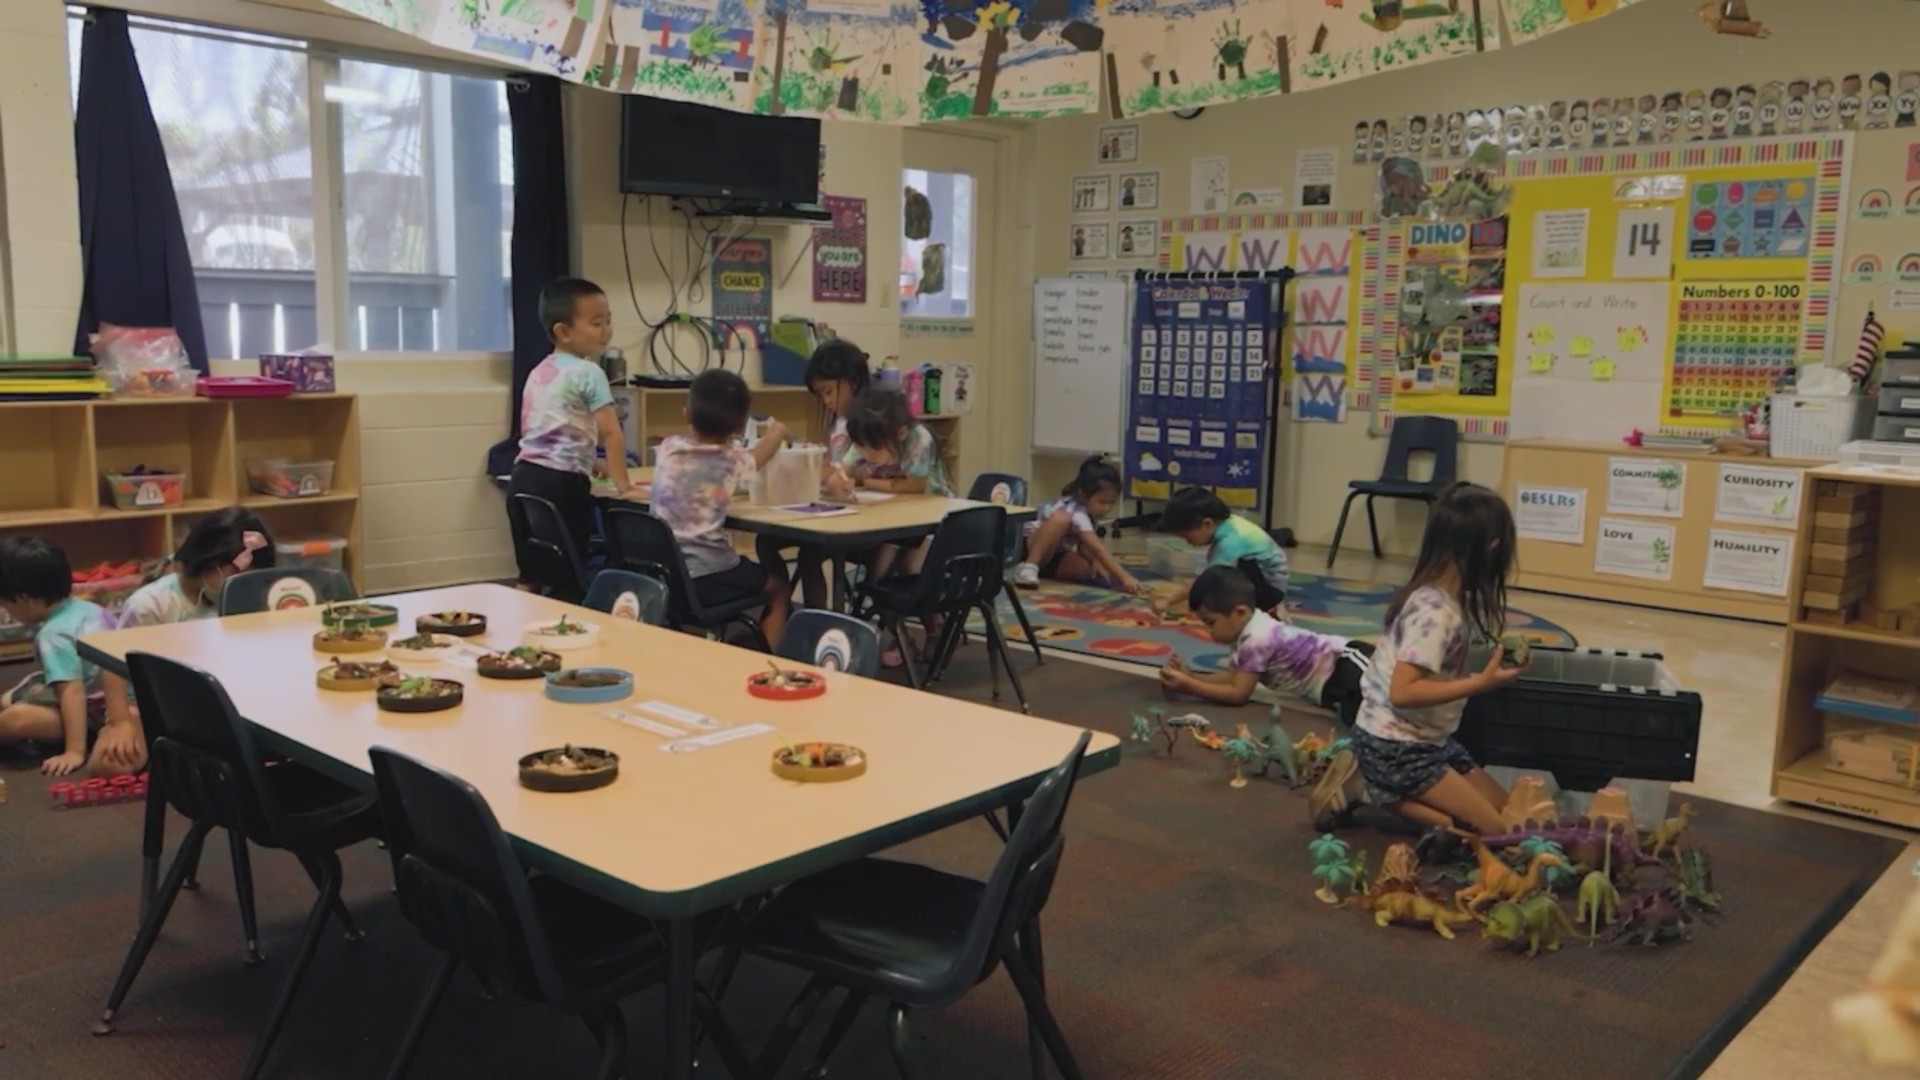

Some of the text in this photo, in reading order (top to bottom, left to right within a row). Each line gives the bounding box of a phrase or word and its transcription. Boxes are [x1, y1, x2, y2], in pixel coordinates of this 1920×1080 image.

[1411, 224, 1466, 246] DINO
[1628, 222, 1660, 256] 14
[1300, 239, 1353, 273] W
[724, 276, 761, 291] CHANCE
[819, 270, 860, 292] HERE
[1683, 284, 1750, 298] Numbers
[1694, 303, 1699, 311] 1
[1706, 303, 1712, 311] 2
[1718, 303, 1724, 311] 3
[1730, 303, 1736, 311] 4
[1217, 334, 1223, 343] 5
[1251, 334, 1257, 342] 7
[1215, 352, 1223, 360] 12
[1250, 352, 1259, 360] 14
[1214, 369, 1222, 377] 19
[1250, 370, 1259, 378] 21
[1176, 385, 1185, 393] 24
[1212, 387, 1222, 395] 26
[1724, 473, 1794, 489] CURIOSITY
[1604, 528, 1633, 541] LOVE
[1713, 539, 1780, 555] HUMILITY
